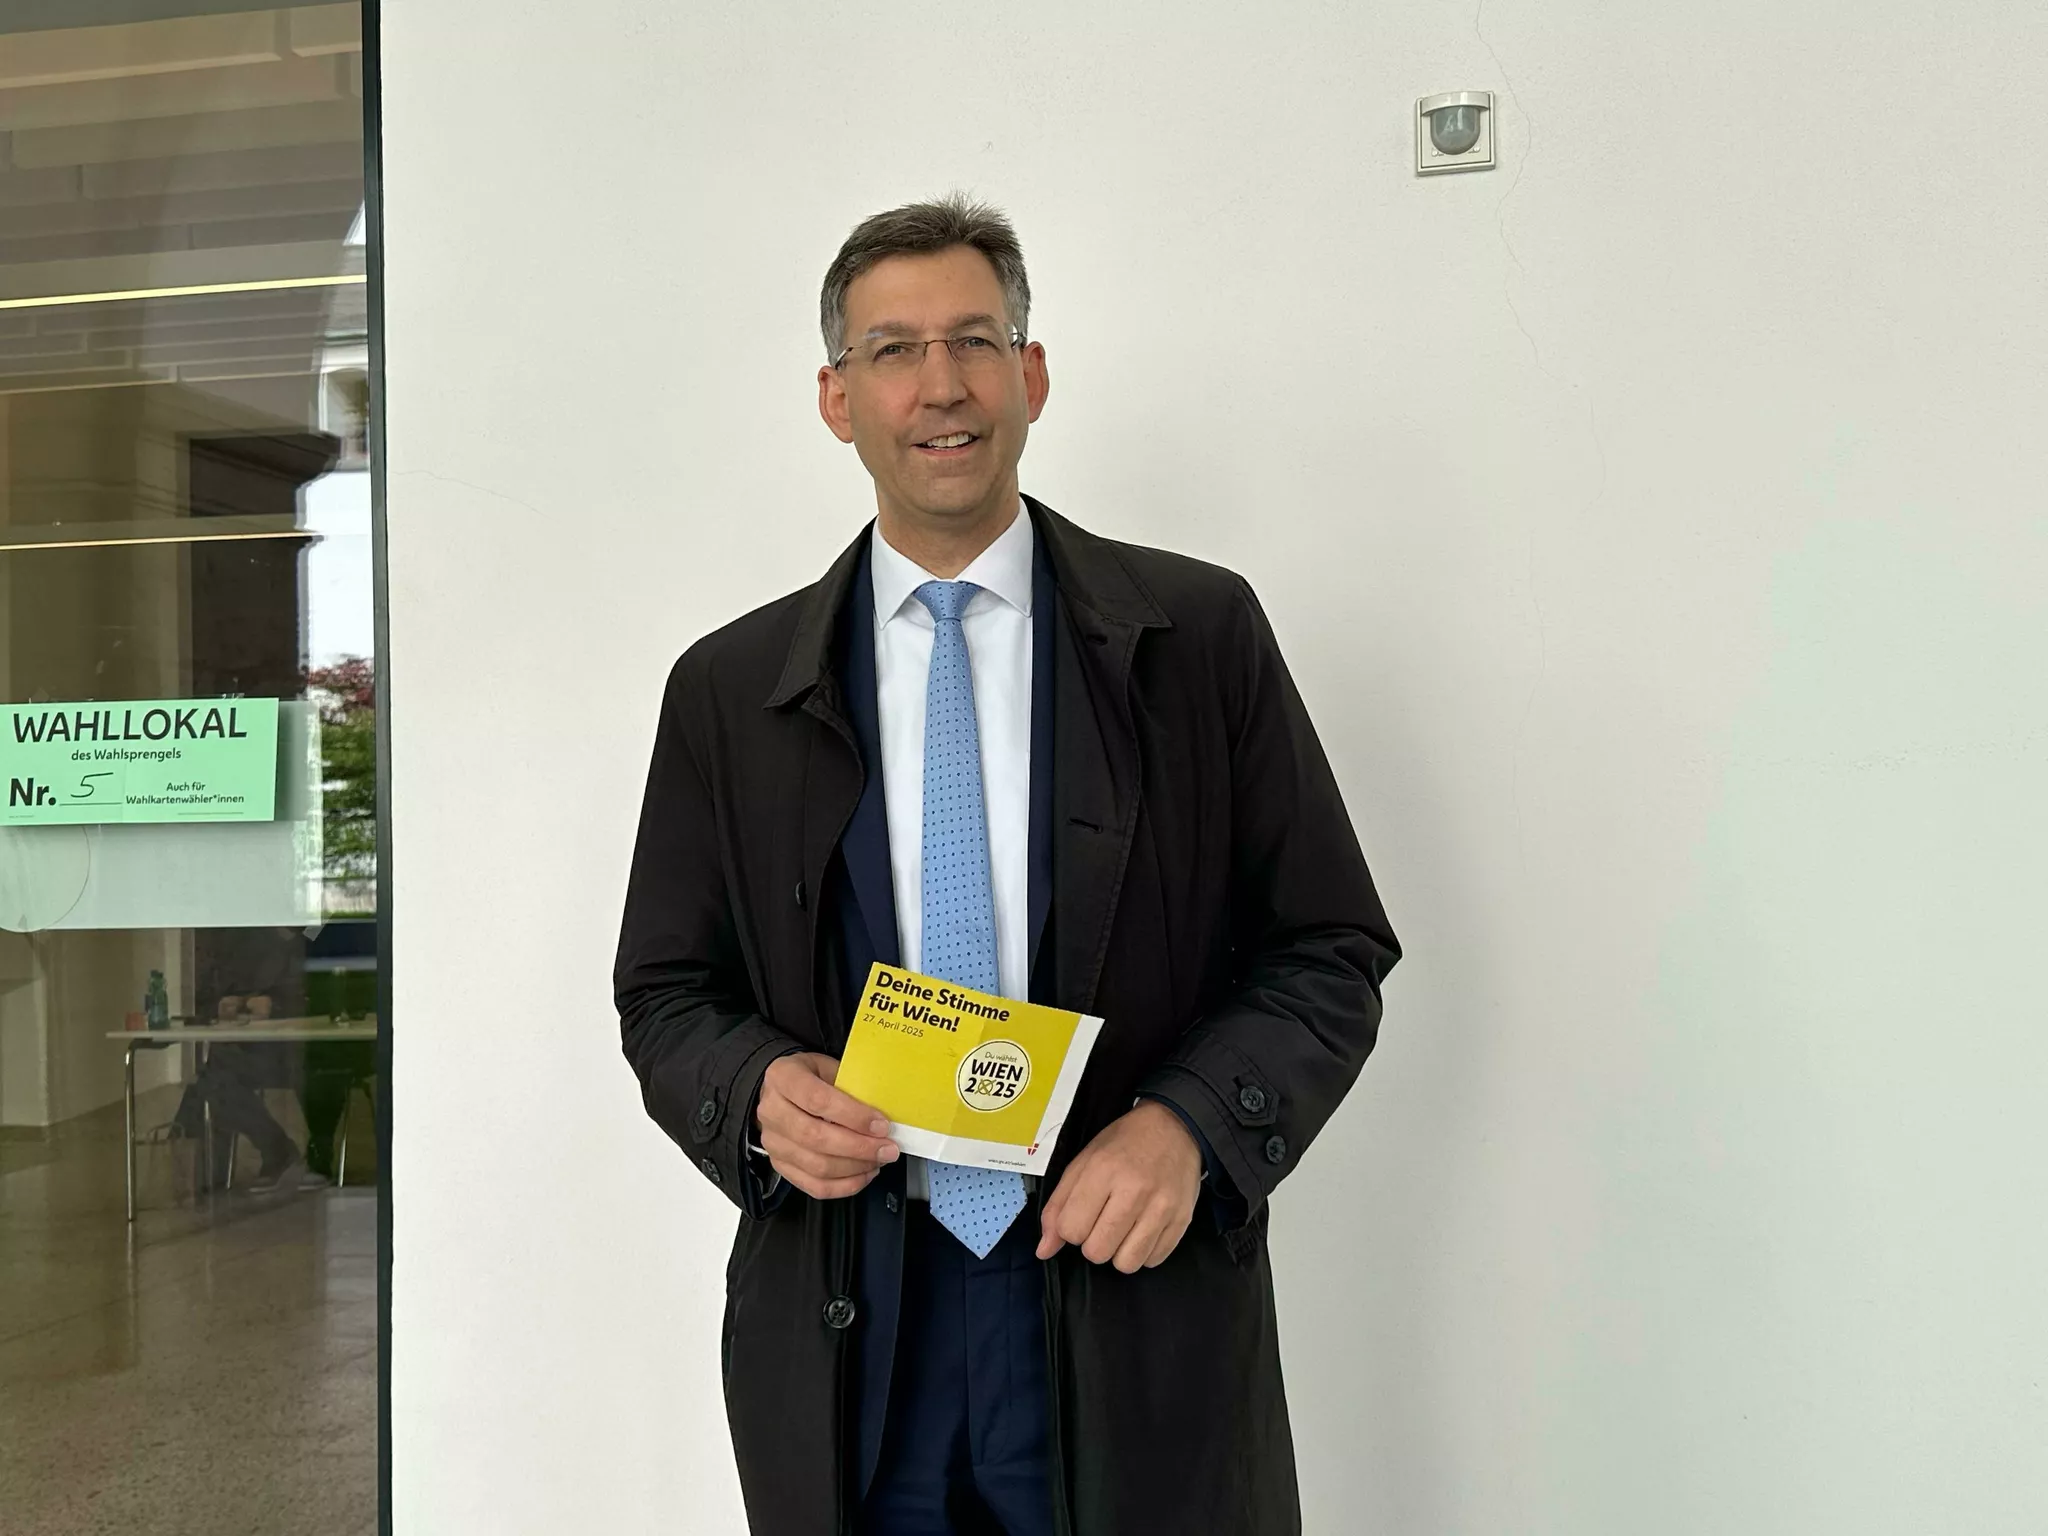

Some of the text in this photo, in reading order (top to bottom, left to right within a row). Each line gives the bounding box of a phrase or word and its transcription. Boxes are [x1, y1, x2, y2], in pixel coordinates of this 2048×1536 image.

[13, 707, 247, 743] WAHLLOKAL
[71, 747, 182, 762] des Wahlsprengels
[9, 777, 57, 807] Nr.
[70, 772, 114, 798] 5
[166, 781, 206, 792] Auch für
[875, 970, 1010, 1022] Deine Stimme
[869, 991, 961, 1033] für Wien!
[877, 1018, 900, 1031] April
[901, 1024, 924, 1038] 2025
[985, 1051, 995, 1060] Du
[971, 1058, 1024, 1082] WIEN
